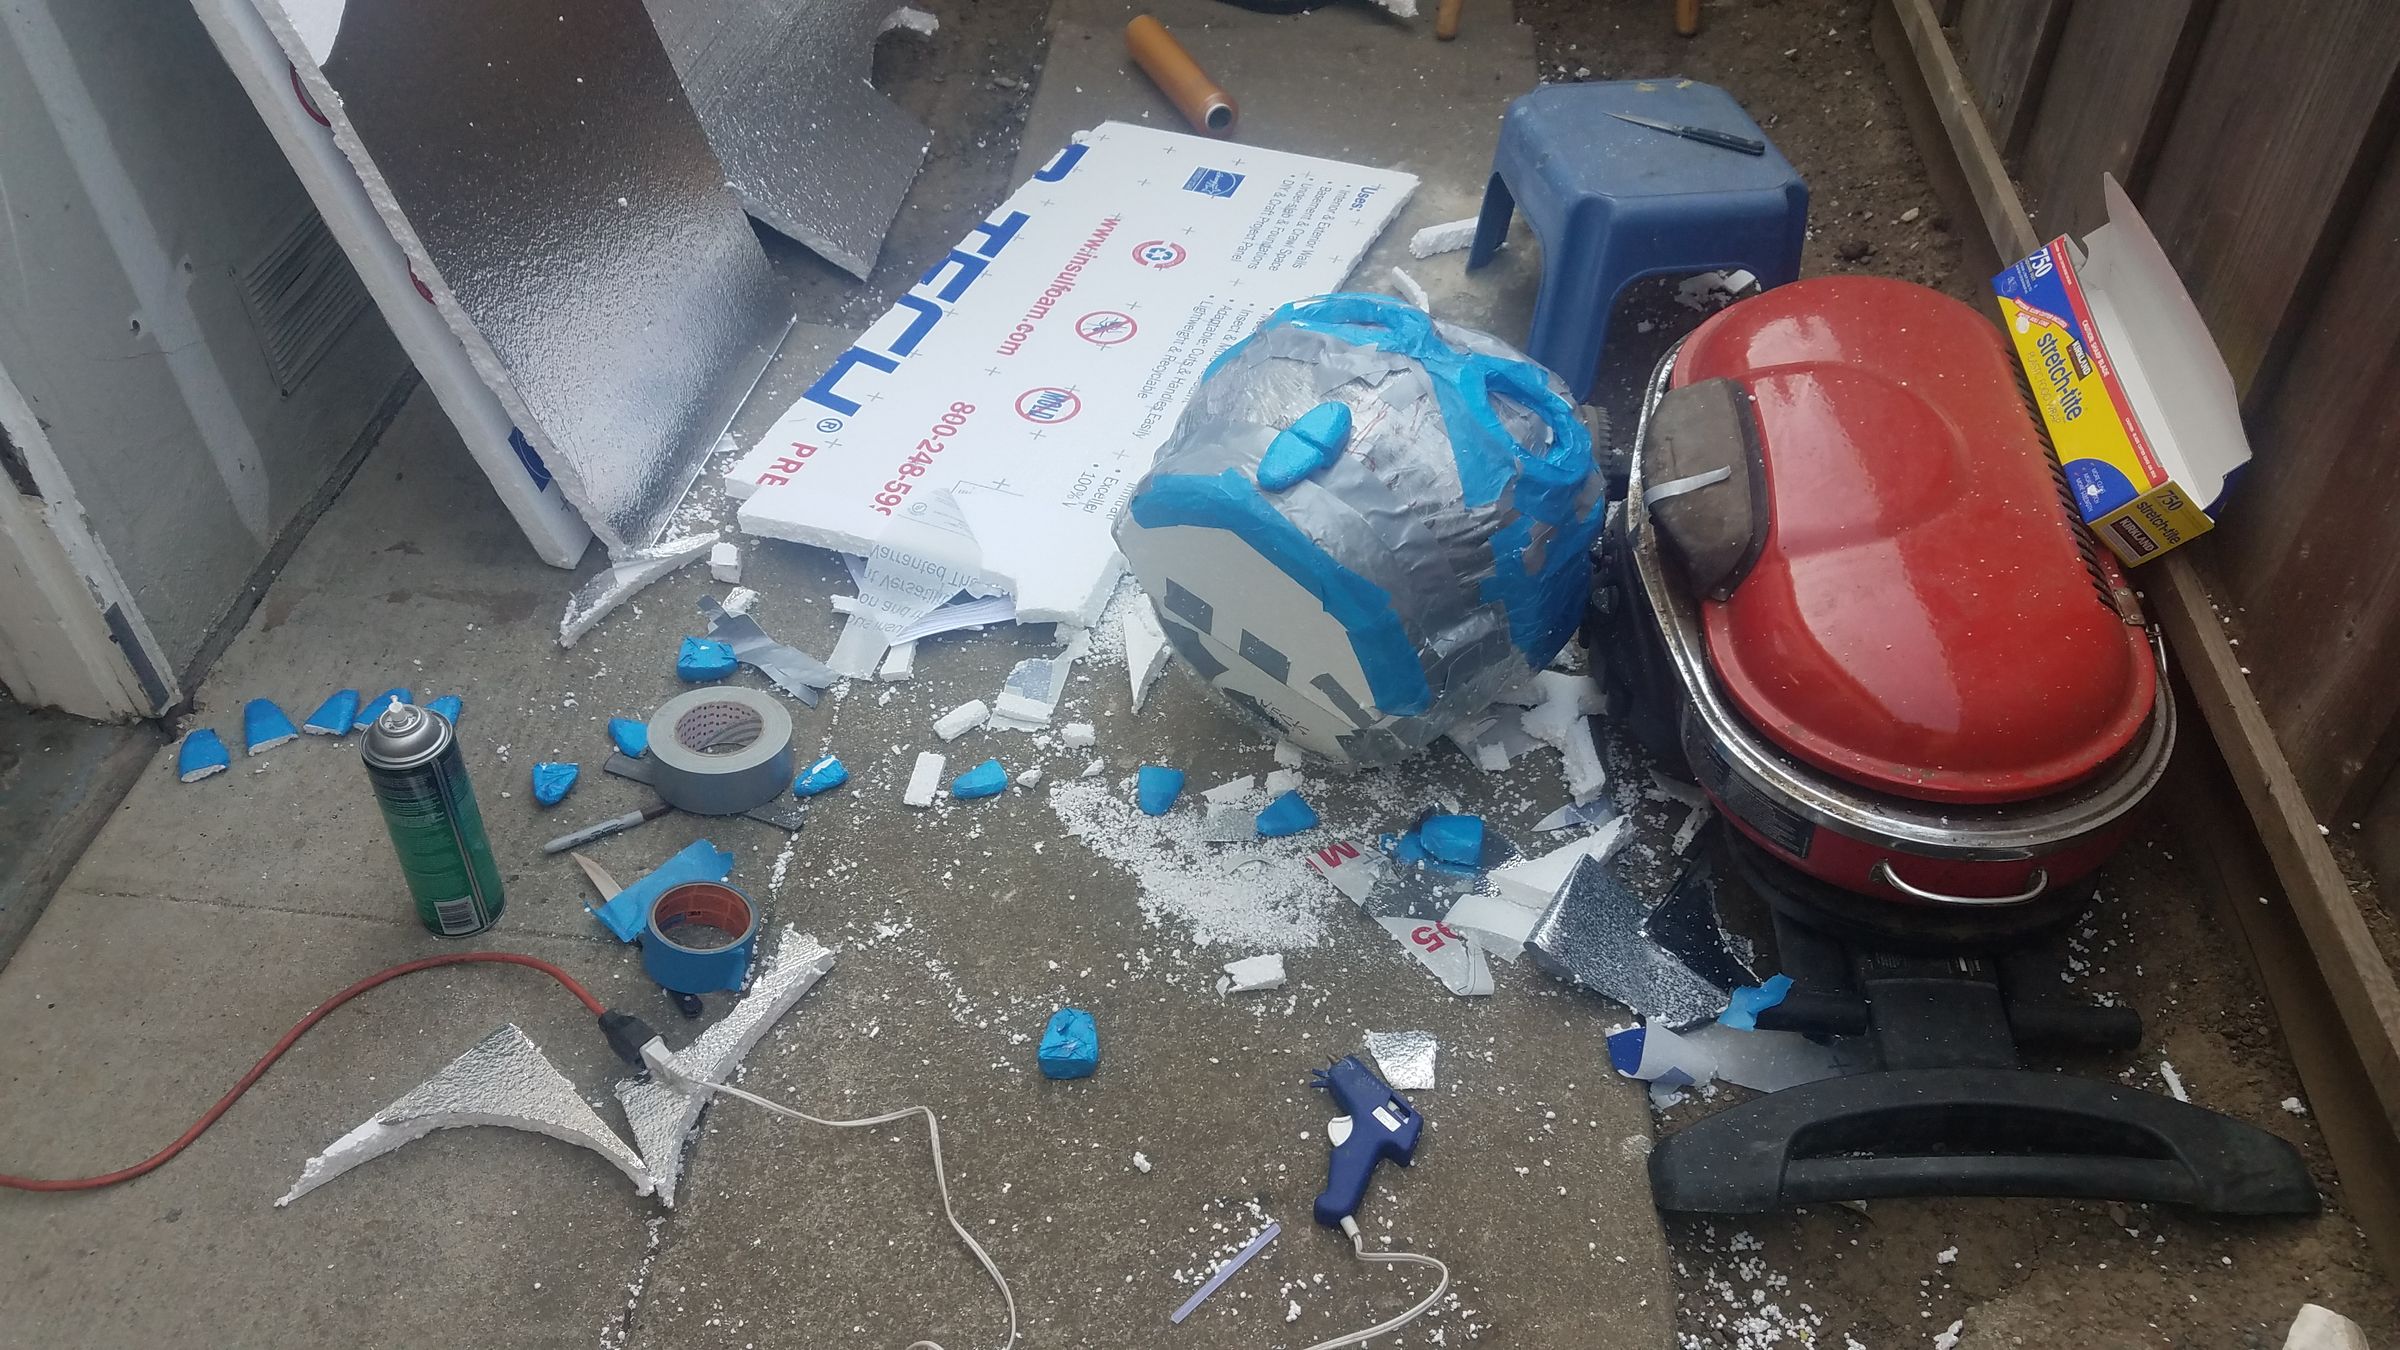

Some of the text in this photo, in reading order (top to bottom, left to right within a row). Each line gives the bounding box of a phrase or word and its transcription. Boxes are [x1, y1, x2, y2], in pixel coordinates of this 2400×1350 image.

[1263, 198, 1282, 216] Craft
[1301, 186, 1332, 220] Basement
[1327, 189, 1350, 214] Interior
[1349, 185, 1376, 212] Uses:
[1248, 216, 1270, 239] Project
[1285, 228, 1305, 250] Crawl
[1305, 221, 1331, 249] Exterior
[1231, 240, 1254, 262] Panel
[1247, 226, 1285, 270] Foundations
[1268, 249, 1293, 272] Space
[1292, 250, 1314, 269] Walls
[2029, 248, 2053, 278] 750
[997, 217, 1120, 356] www.insulfoam.com
[1173, 300, 1213, 347] Lightweight
[1230, 310, 1253, 334] Insect
[1182, 347, 1205, 367] Cuts
[2072, 340, 2091, 375] KIRKLAND
[1137, 354, 1177, 399] Recyclable
[2036, 333, 2082, 421] stretch-tite
[1153, 377, 1186, 412] Handles
[1132, 413, 1162, 439] Easily
[2157, 490, 2184, 511] 750
[2120, 517, 2155, 551] KIRKLAND
[2137, 501, 2181, 545] stretch-tite
